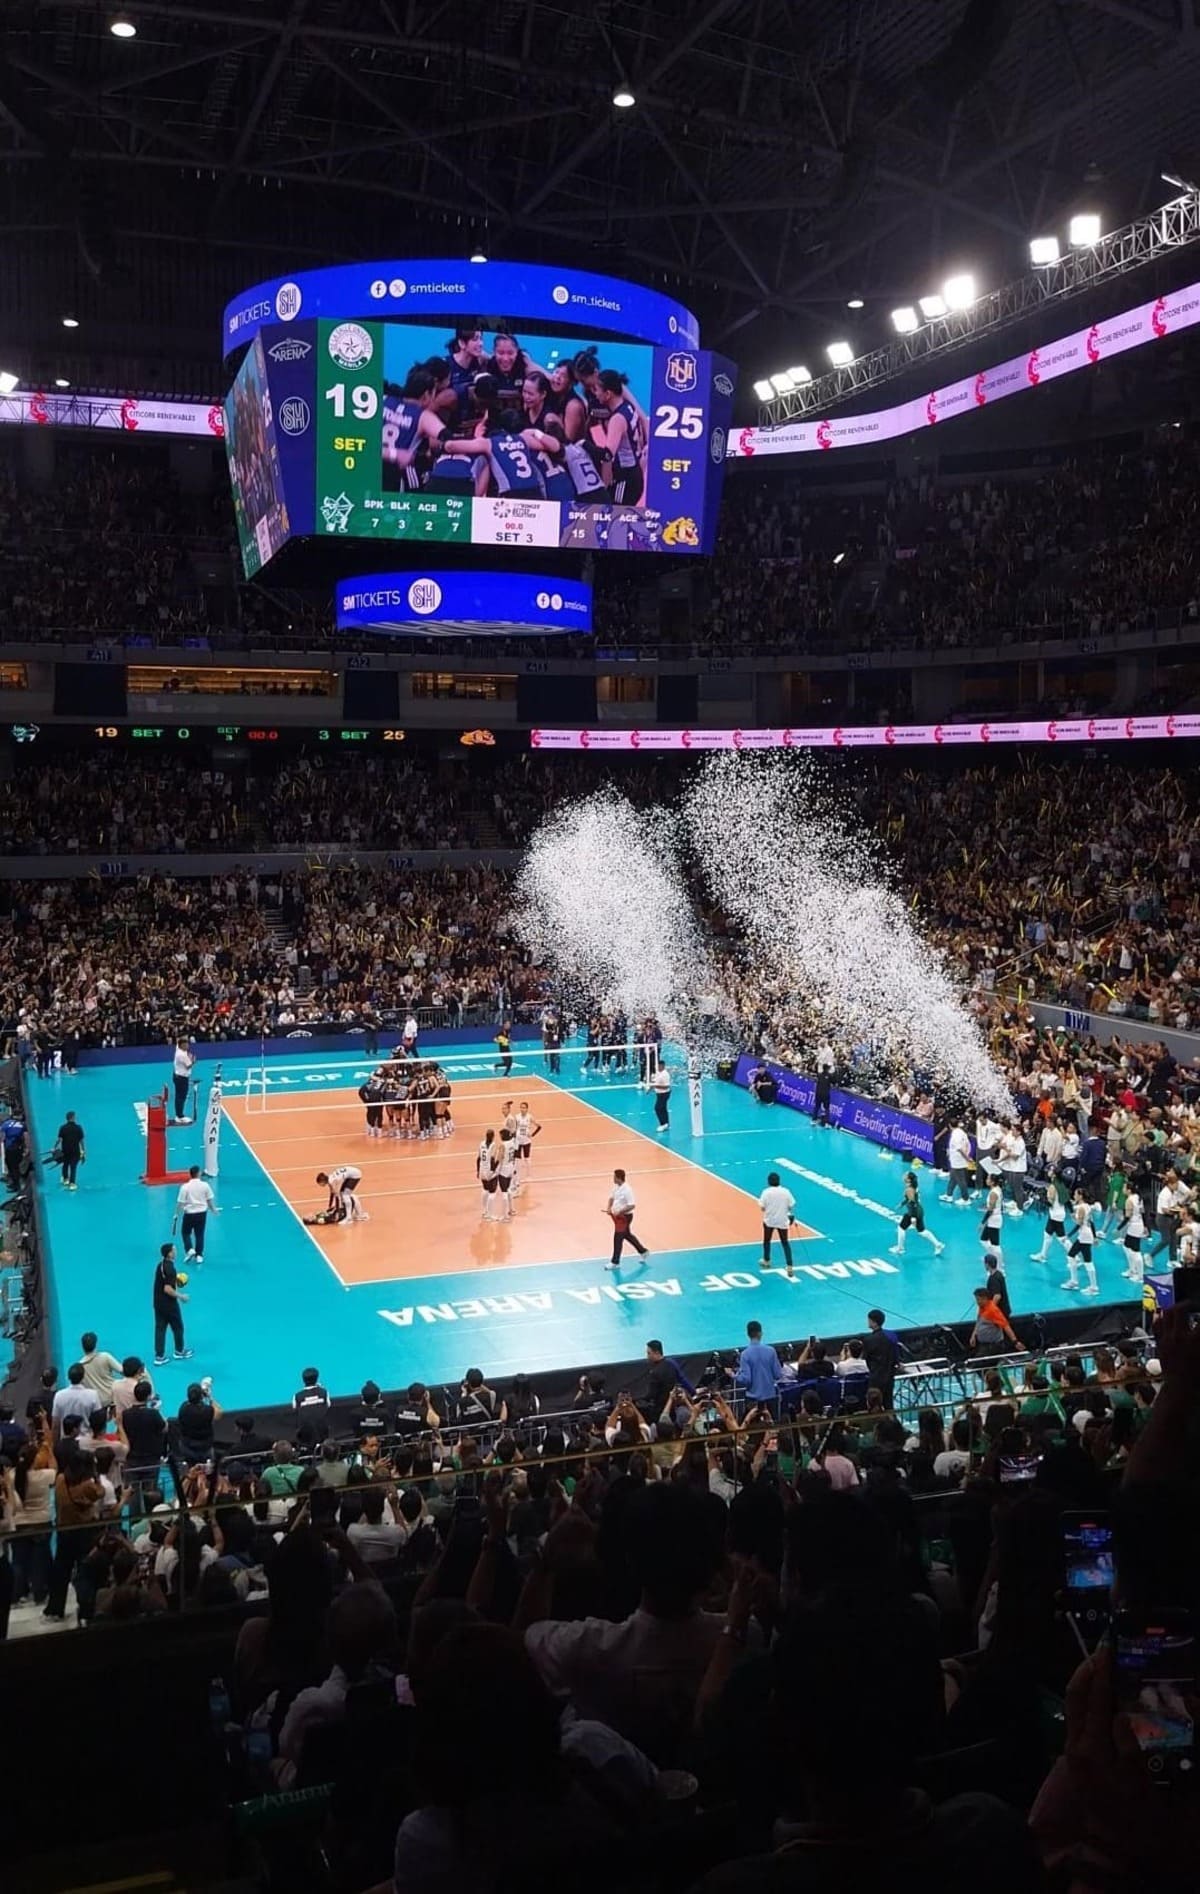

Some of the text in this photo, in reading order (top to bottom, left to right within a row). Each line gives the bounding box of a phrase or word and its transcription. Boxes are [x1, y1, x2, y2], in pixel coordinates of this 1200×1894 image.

[410, 282, 466, 294] smtickets
[326, 383, 378, 420] 19
[654, 405, 704, 440] 25
[334, 437, 366, 451] SET
[345, 457, 355, 470] 0
[509, 451, 532, 478] 3
[662, 459, 691, 473] SET
[579, 462, 600, 487] 5
[671, 477, 681, 490] 3
[364, 500, 384, 509] SPK
[418, 503, 437, 512] ACE
[446, 499, 463, 509] Opp
[568, 512, 587, 520] SPK
[620, 514, 638, 522] ACE
[645, 510, 660, 519] Opp
[372, 518, 459, 532] 7 3 2 7
[495, 532, 533, 543] SET 3
[572, 529, 585, 538] 15
[601, 531, 607, 539] 4
[628, 532, 633, 540] 1
[95, 727, 118, 737] 19
[132, 729, 164, 737] SET
[319, 731, 329, 740] 3
[341, 731, 370, 740] SET
[383, 731, 405, 740] 25
[854, 1108, 890, 1140] Elevating
[377, 1257, 900, 1327] MALL OF ASIA ARENA
